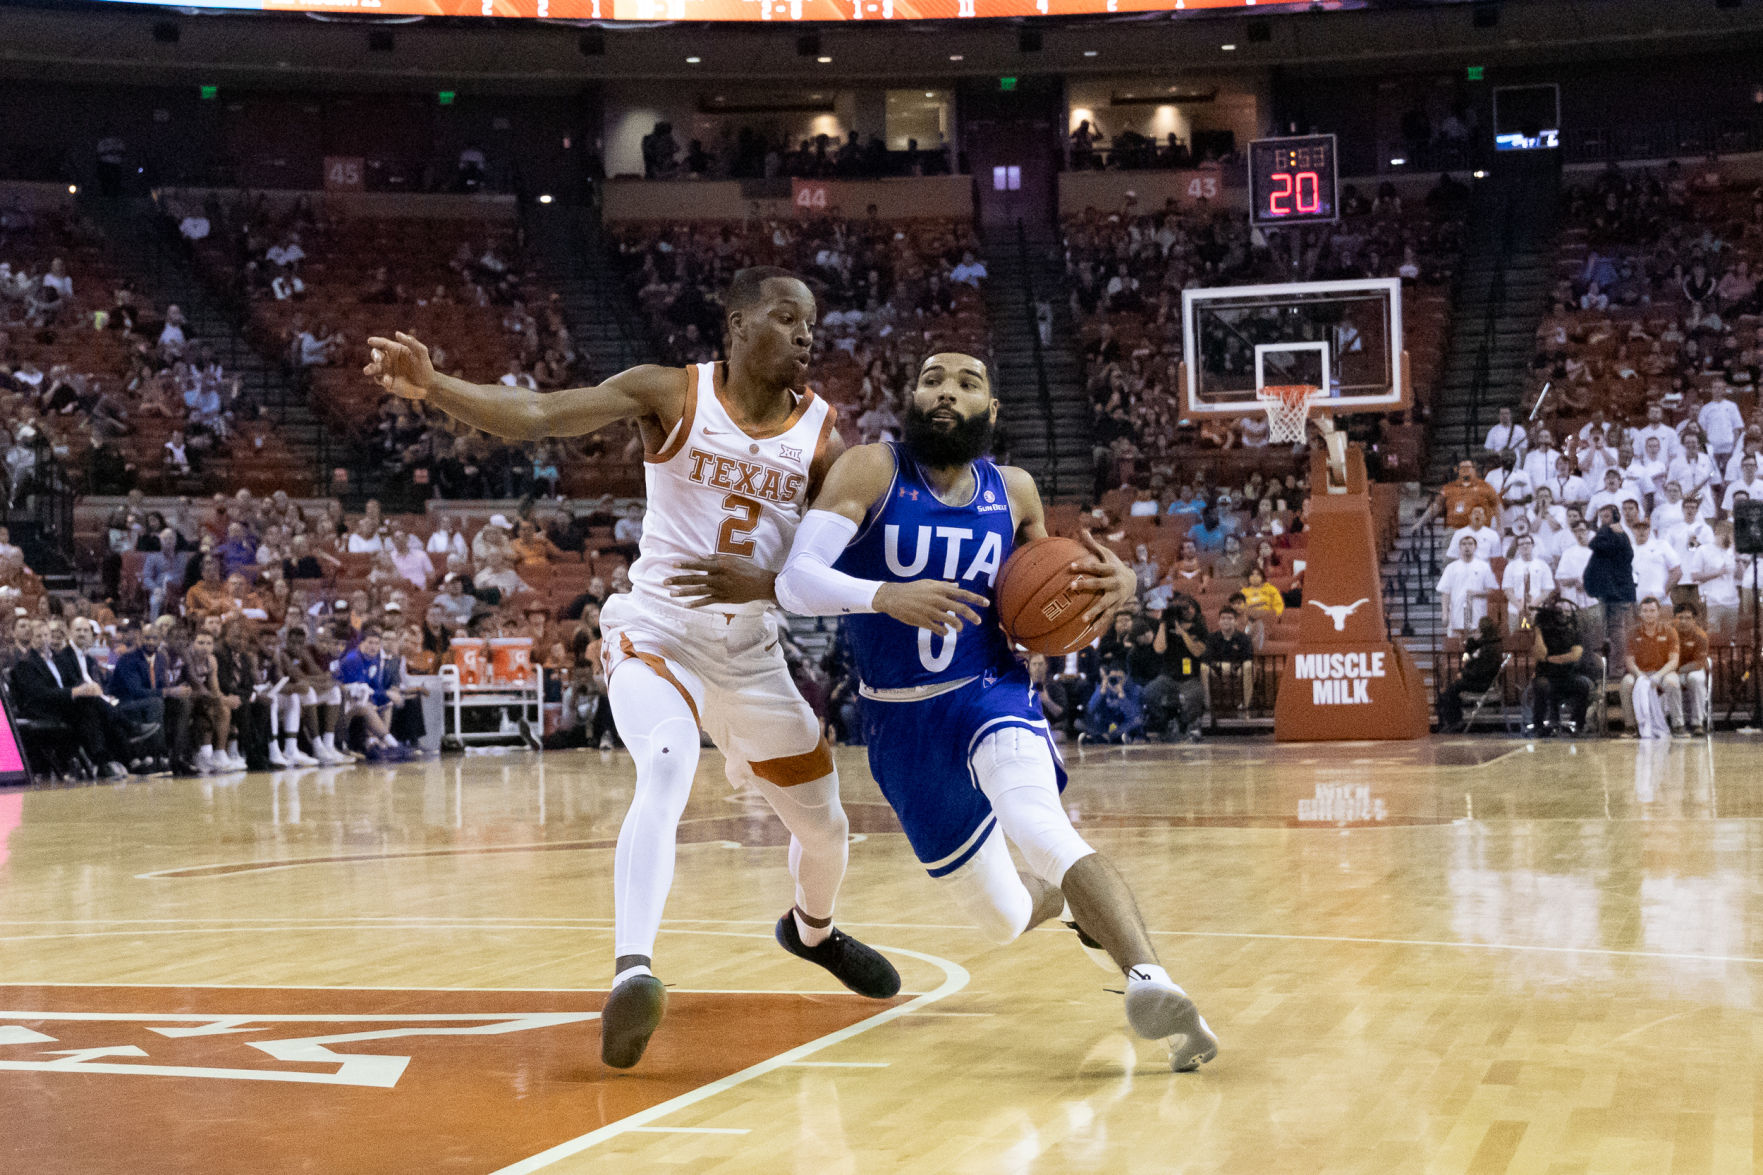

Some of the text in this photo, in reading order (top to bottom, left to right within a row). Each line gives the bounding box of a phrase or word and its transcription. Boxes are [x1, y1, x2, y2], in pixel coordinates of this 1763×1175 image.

[797, 189, 826, 208] 44
[1188, 178, 1216, 198] 43
[1270, 171, 1319, 214] 20
[689, 447, 806, 503] TEXAS
[715, 492, 763, 559] 2
[885, 524, 1002, 588] UTA
[1295, 652, 1385, 679] MUSCLE
[1312, 678, 1370, 705] MILK
